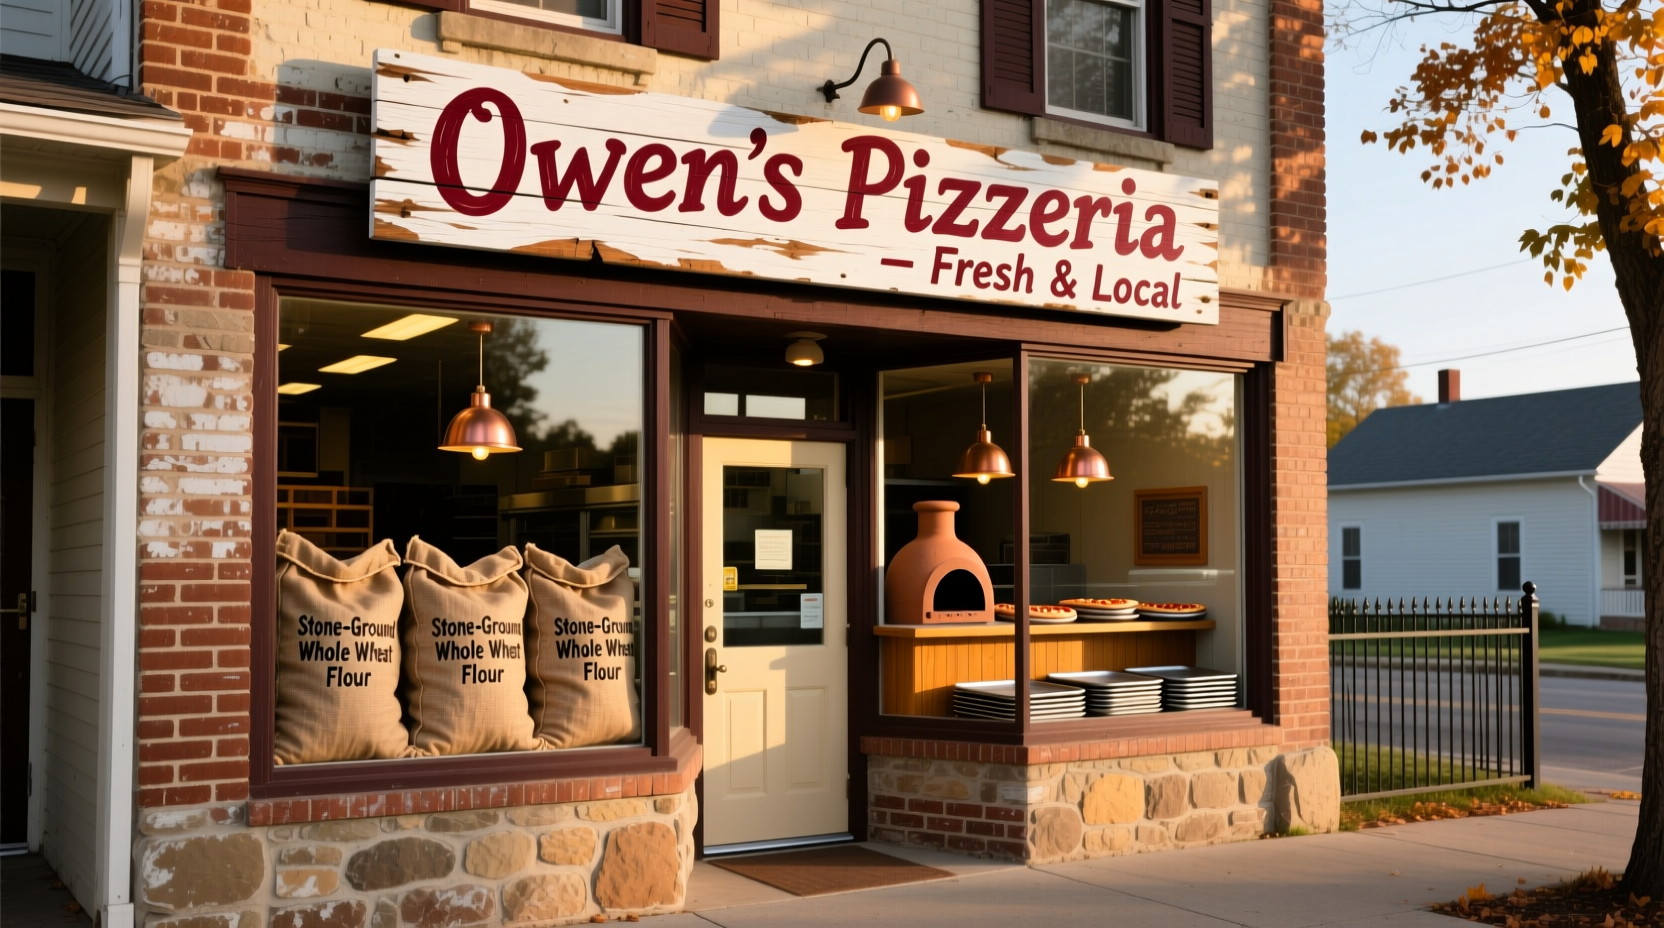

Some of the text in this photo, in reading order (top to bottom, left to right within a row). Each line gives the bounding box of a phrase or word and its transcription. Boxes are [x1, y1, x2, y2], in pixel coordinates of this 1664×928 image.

[430, 87, 1184, 261] Owen's Pizzeria
[930, 246, 1034, 294] Fresh
[1050, 259, 1077, 299] &
[1092, 264, 1182, 310] Local
[297, 614, 395, 639] Stone-Ground
[299, 640, 350, 661] Whole
[435, 639, 484, 661] Whole
[555, 638, 602, 659] Whole
[326, 666, 371, 687] Flour
[462, 663, 504, 684] Flour
[584, 661, 622, 681] Flour
